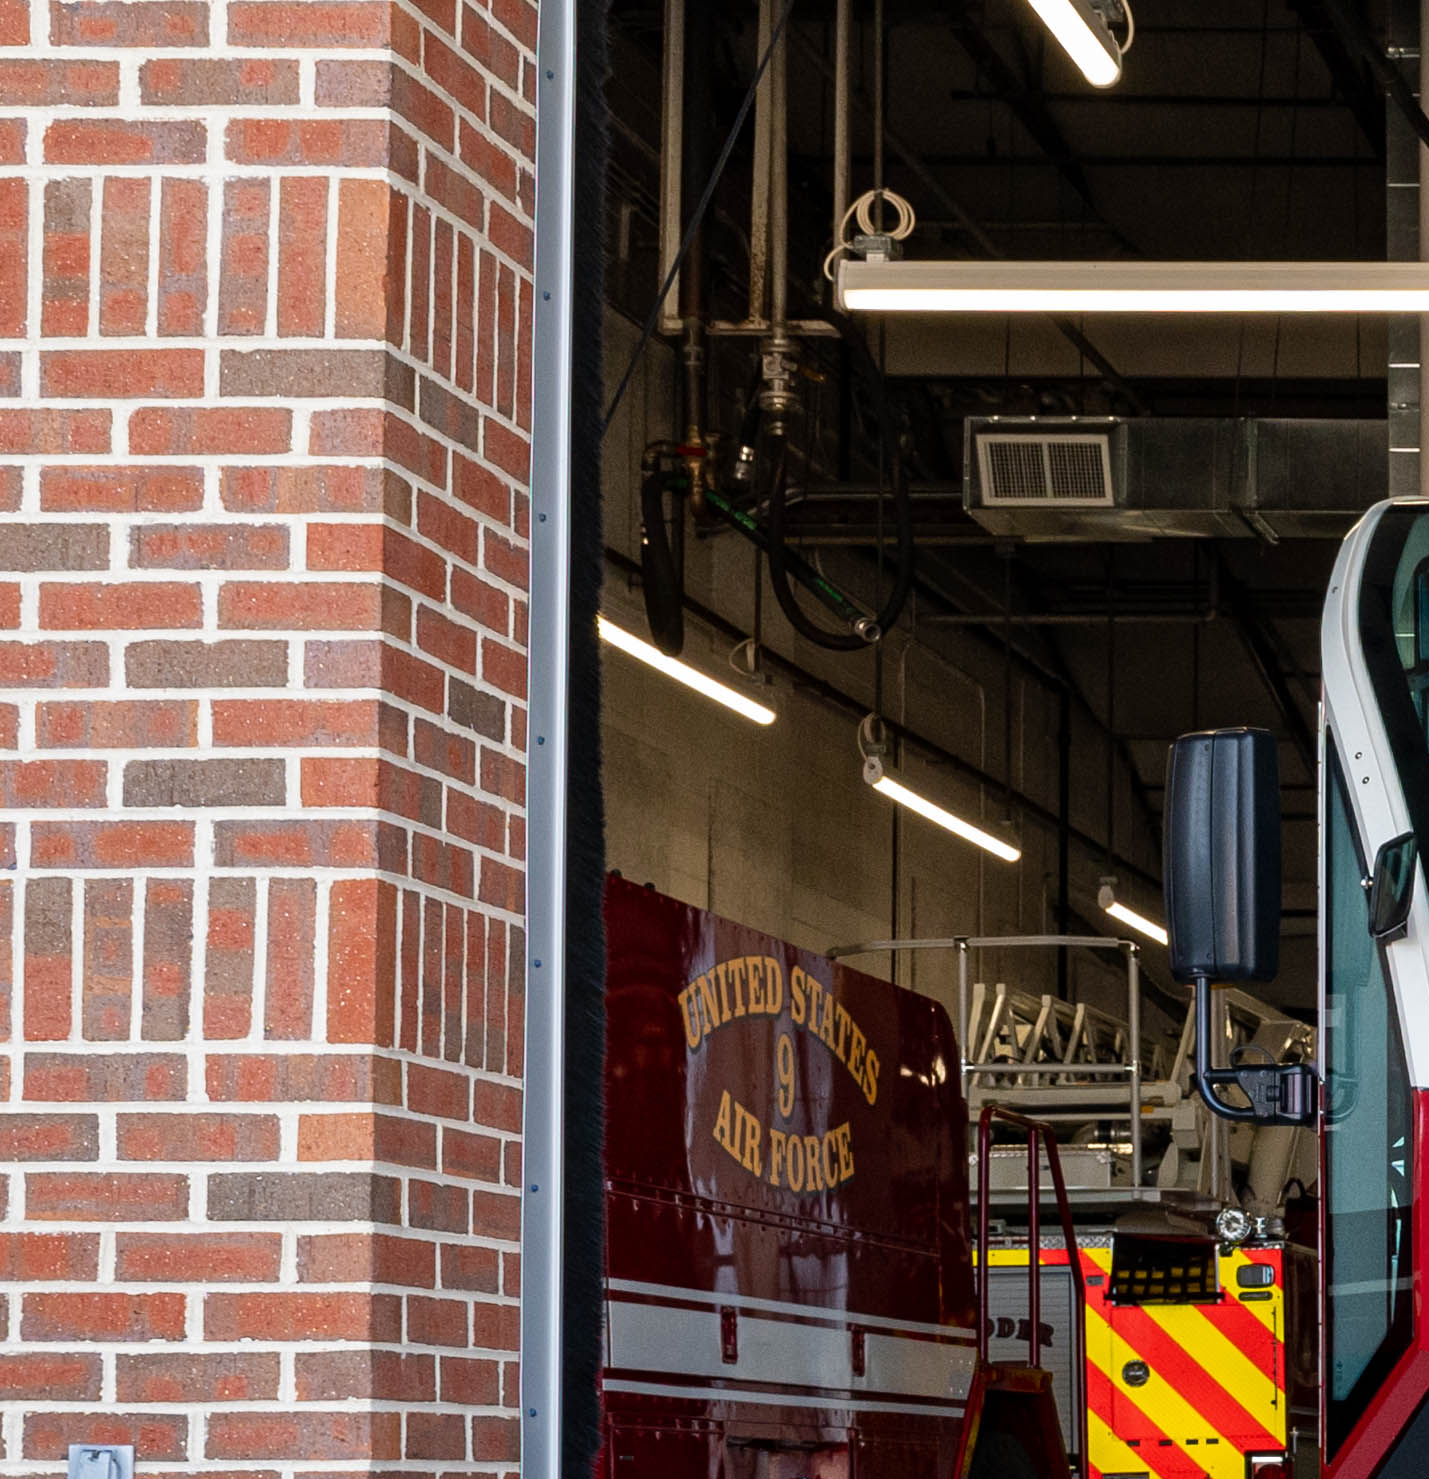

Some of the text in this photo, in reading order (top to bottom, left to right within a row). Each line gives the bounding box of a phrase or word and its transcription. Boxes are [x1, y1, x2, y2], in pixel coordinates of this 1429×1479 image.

[678, 955, 881, 1105] UNITED STATES
[777, 1034, 795, 1118] 9
[713, 1089, 855, 1193] AIR FORCE
